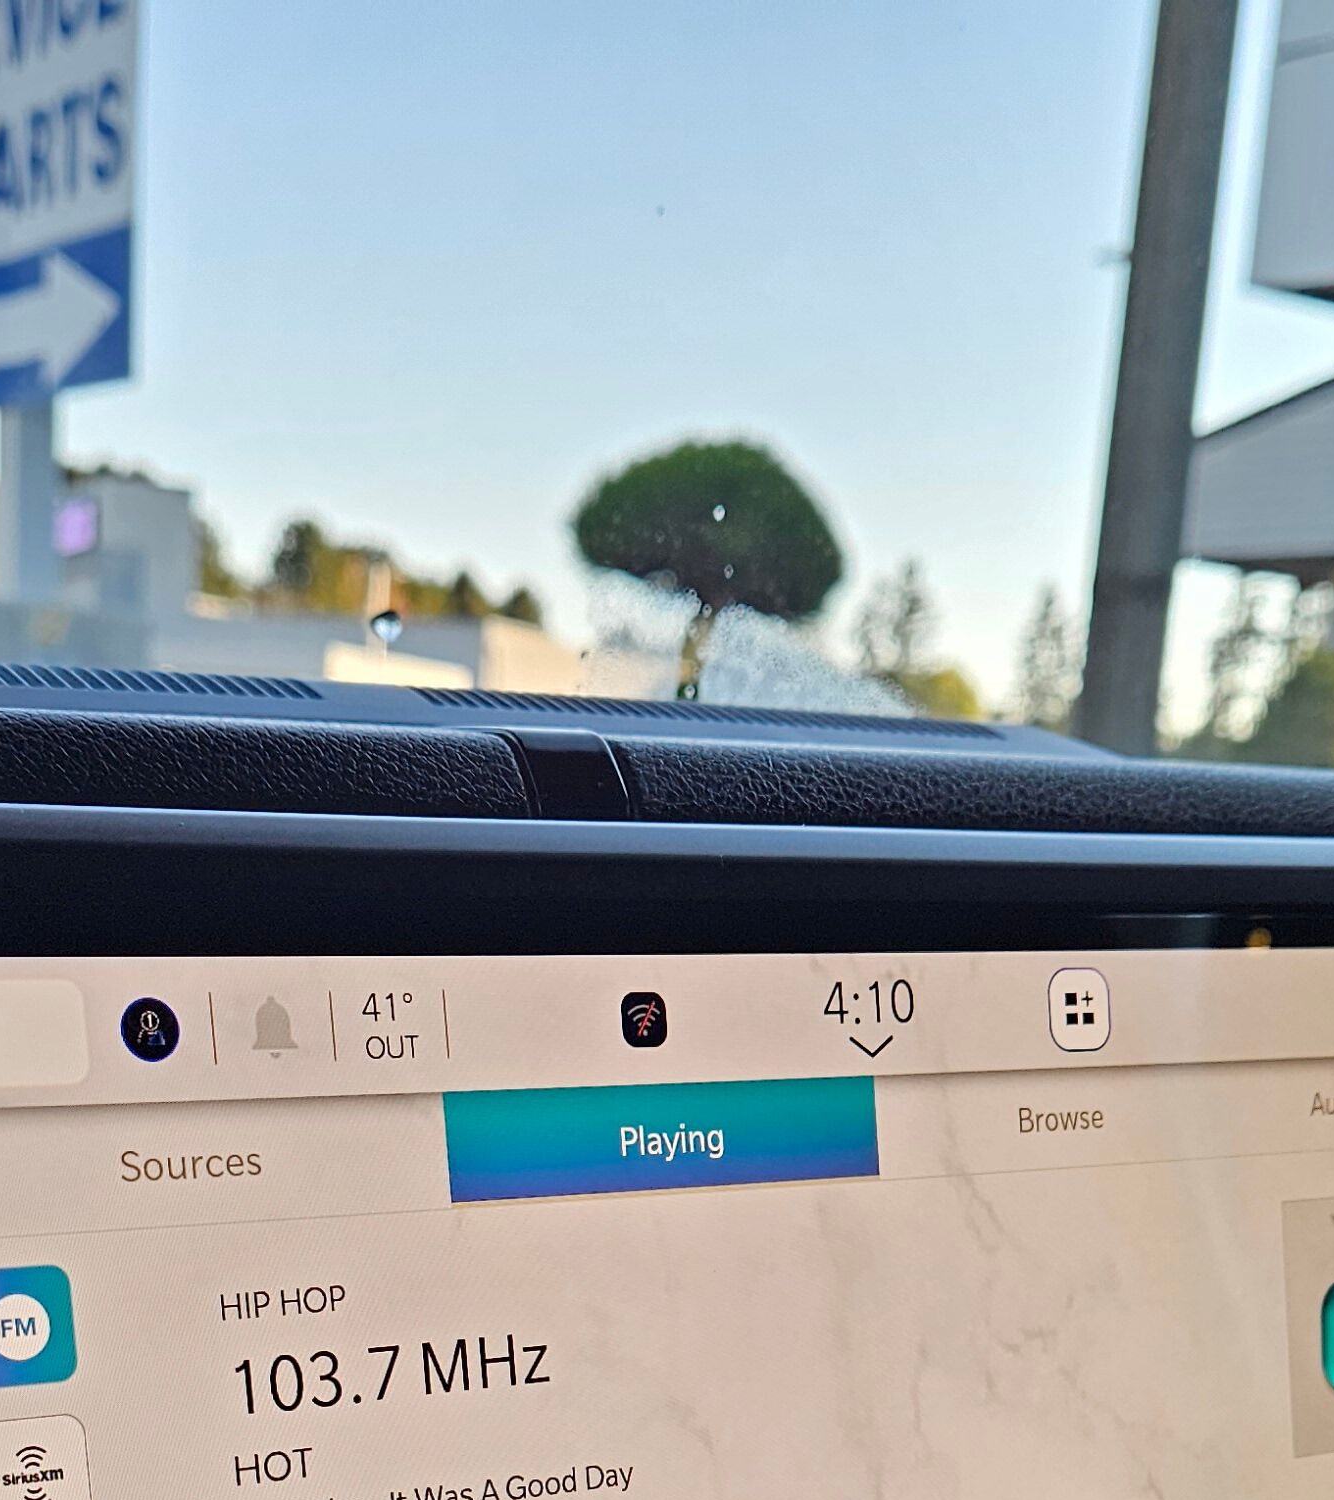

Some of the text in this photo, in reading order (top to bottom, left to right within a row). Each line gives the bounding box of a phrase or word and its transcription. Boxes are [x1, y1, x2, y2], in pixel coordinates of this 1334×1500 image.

[362, 992, 414, 1024] 41°
[824, 980, 915, 1024] 4:10
[366, 1034, 418, 1061] OUT
[1018, 1105, 1104, 1134] Browse
[621, 1124, 724, 1161] Playing
[120, 1148, 262, 1184] Sources
[219, 1286, 345, 1321] HIP HOP
[0, 1317, 37, 1339] FM
[235, 1335, 550, 1414] 103.7 MHz
[234, 1448, 313, 1486] HOT
[586, 1463, 633, 1492] Day
